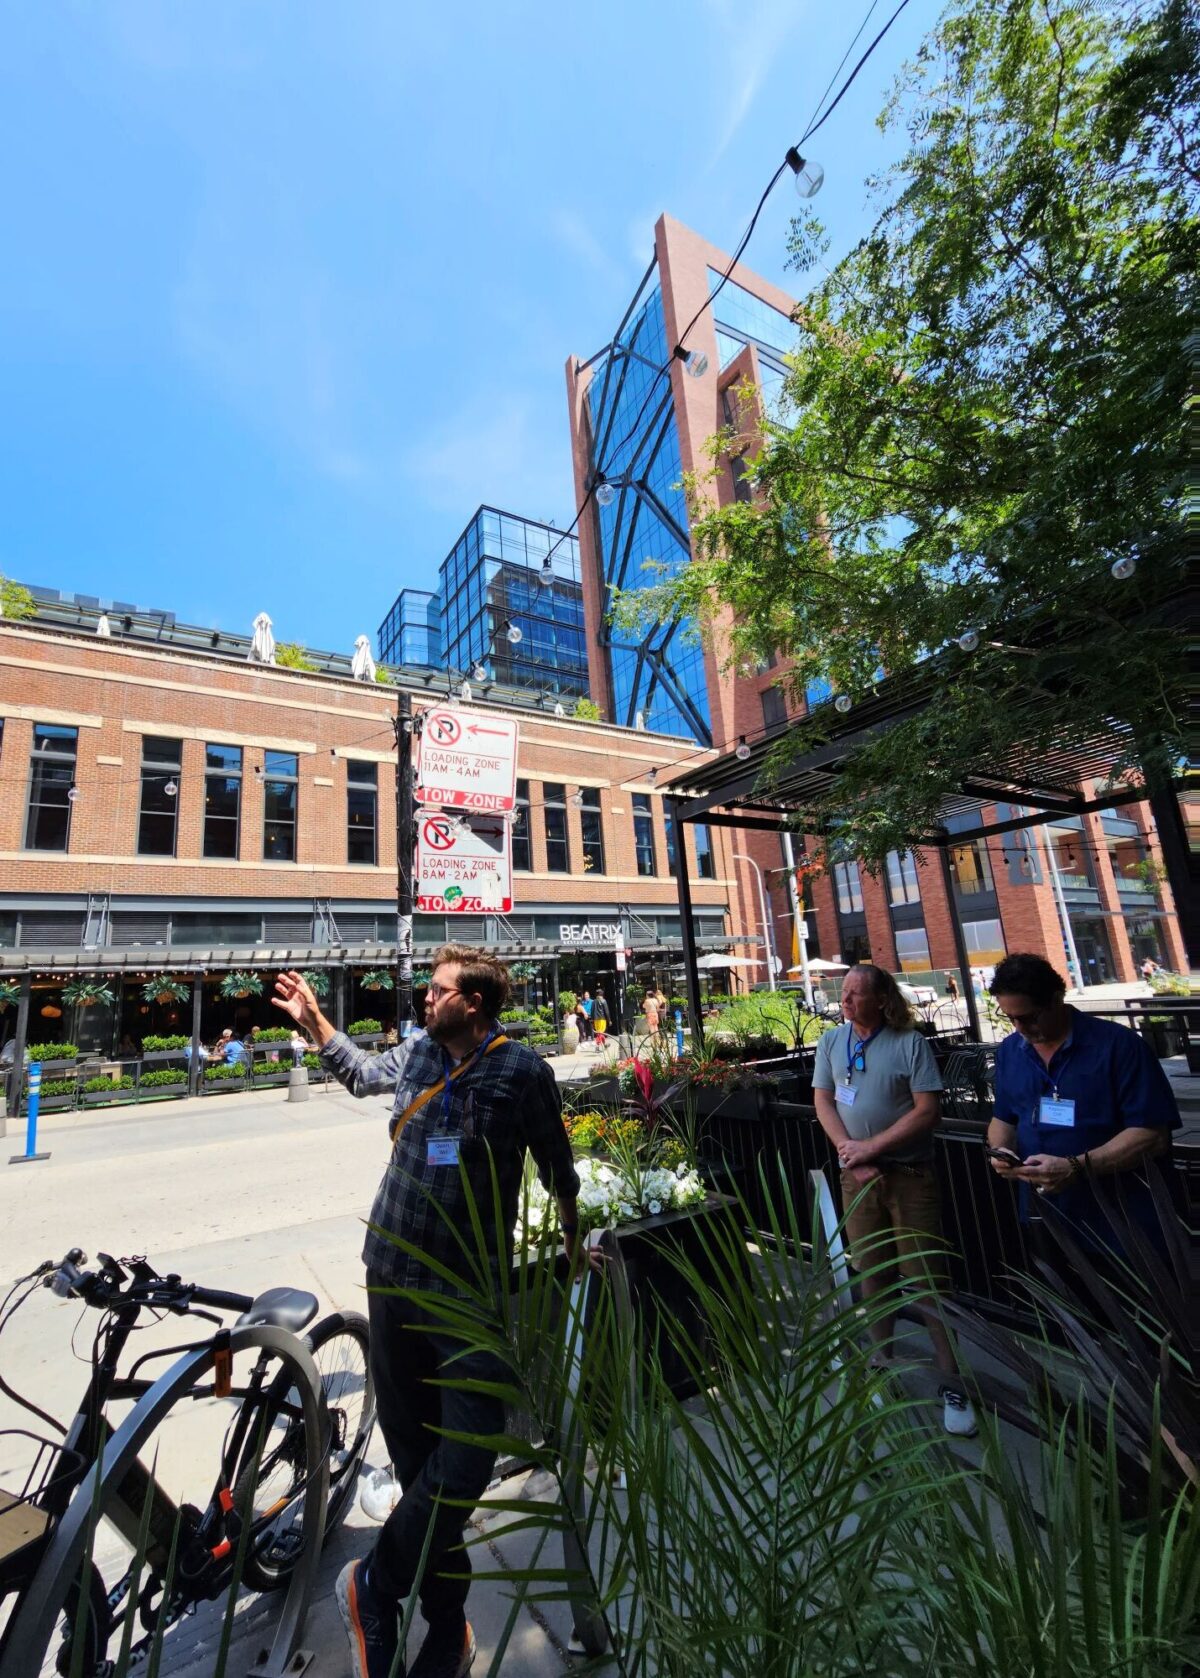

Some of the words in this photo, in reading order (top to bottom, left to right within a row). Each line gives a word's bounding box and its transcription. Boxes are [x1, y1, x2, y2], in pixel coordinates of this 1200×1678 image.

[424, 752, 469, 766] LOADING
[474, 758, 501, 770] ZONE
[423, 787, 456, 803] TOW
[463, 792, 505, 809] ZONE
[422, 858, 466, 869] LOADING
[472, 860, 497, 871] ZONE
[559, 924, 622, 941] BEATRIX
